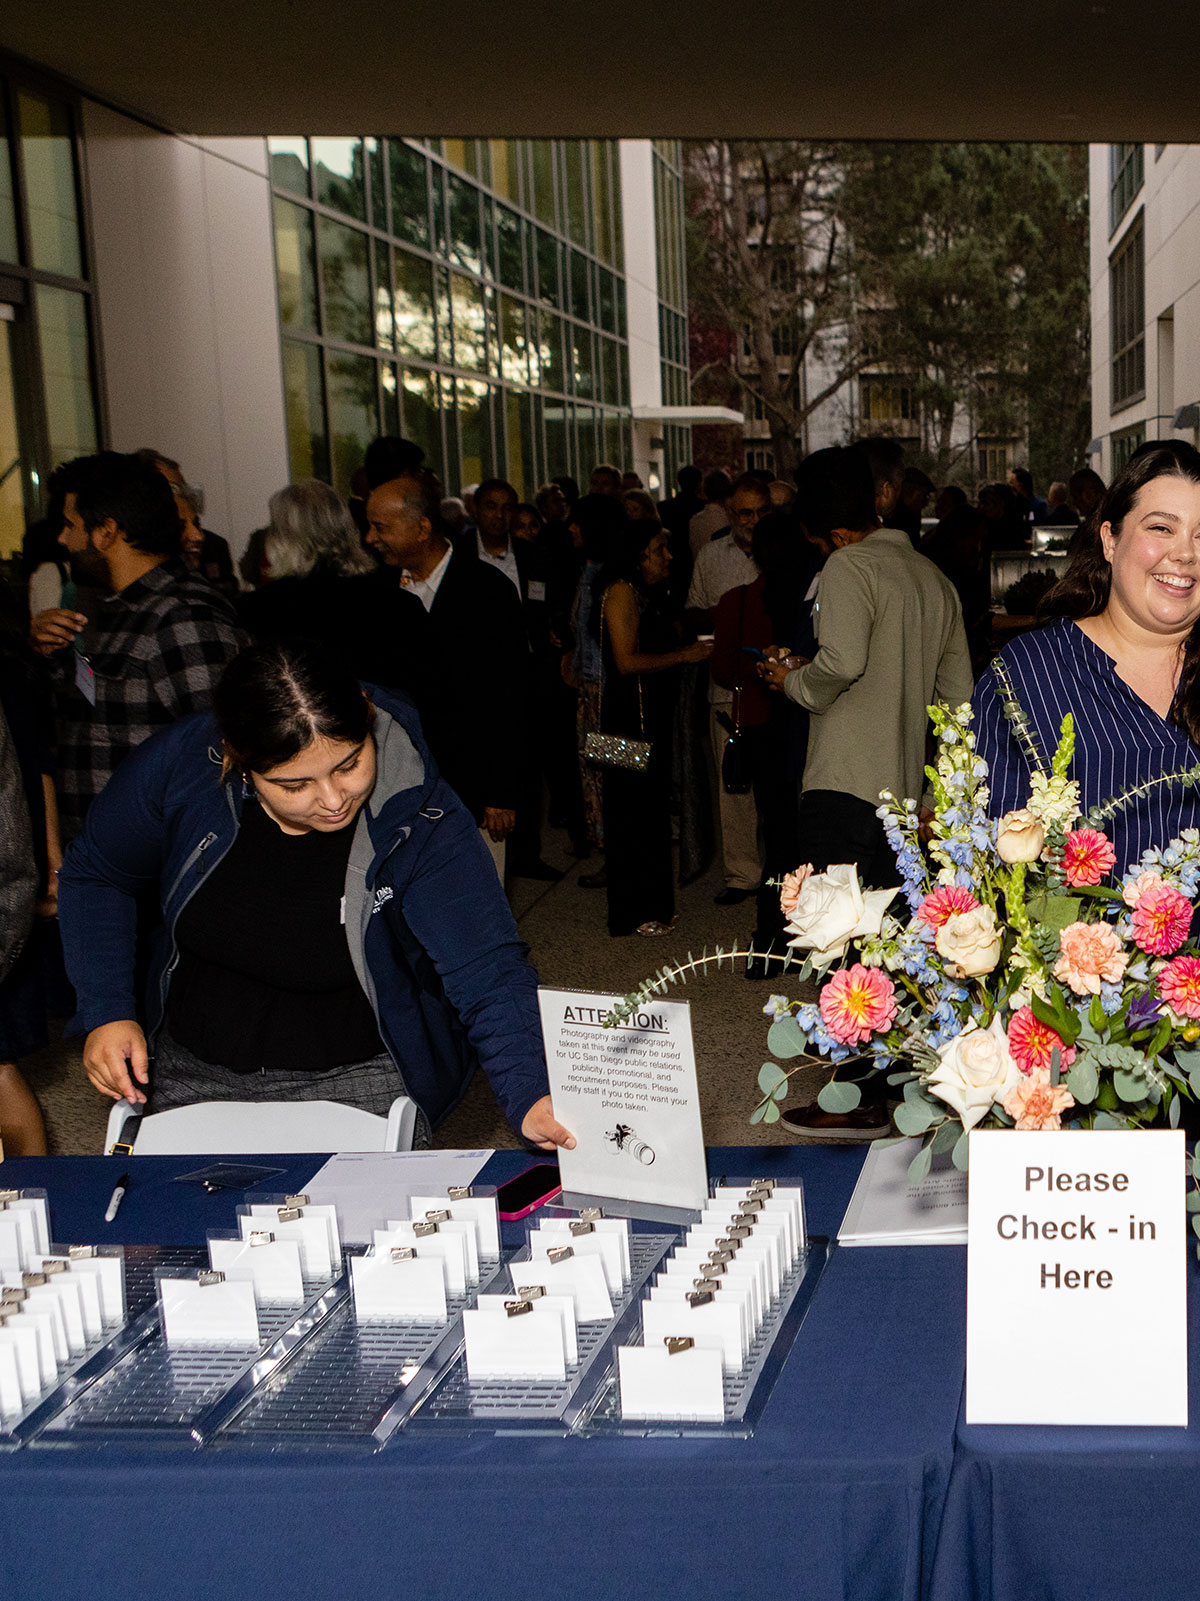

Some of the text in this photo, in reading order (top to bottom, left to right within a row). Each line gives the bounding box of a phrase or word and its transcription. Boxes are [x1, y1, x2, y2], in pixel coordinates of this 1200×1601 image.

[564, 1006, 668, 1030] ATTEION:
[560, 1028, 676, 1049] Photography and videography
[559, 1040, 681, 1060] taken at this event may be used
[556, 1050, 686, 1072] for UC San Diego public relations,
[572, 1064, 605, 1074] publicity,
[607, 1068, 654, 1080] promotional,
[568, 1074, 678, 1093] recruitment purposes. Please
[561, 1085, 581, 1094] notify
[584, 1087, 600, 1095] staff
[602, 1088, 606, 1096] if
[608, 1090, 622, 1098] you
[624, 1091, 634, 1099] do
[650, 1095, 669, 1103] want
[670, 1098, 687, 1106] your
[602, 1100, 648, 1112] photo taken.
[1025, 1166, 1129, 1192] Please
[996, 1214, 1096, 1240] Check
[1129, 1214, 1156, 1240] in
[1040, 1263, 1113, 1289] Here
